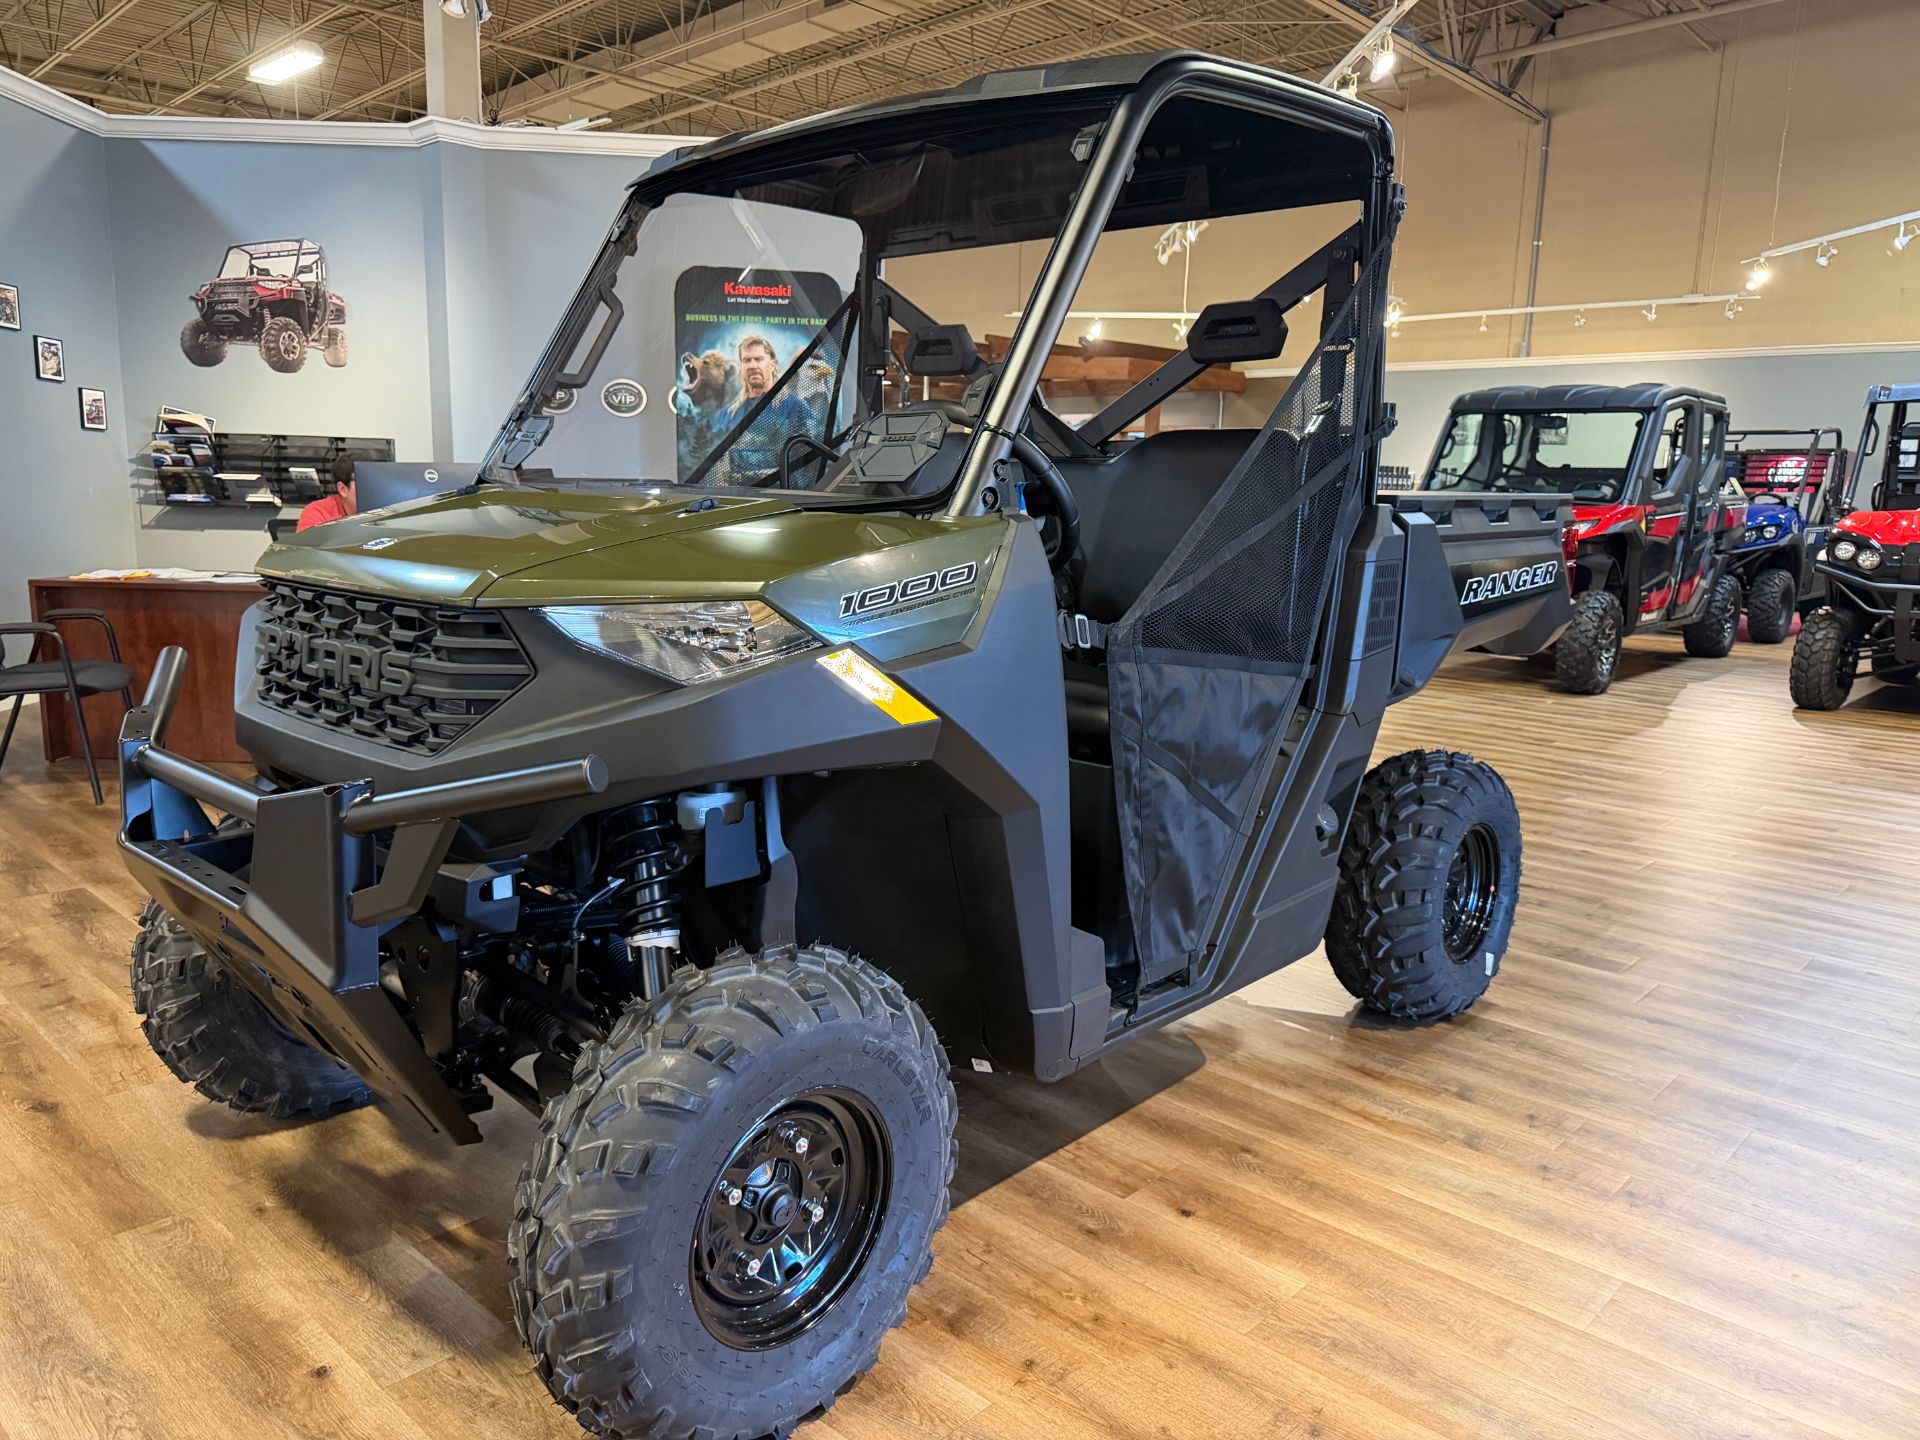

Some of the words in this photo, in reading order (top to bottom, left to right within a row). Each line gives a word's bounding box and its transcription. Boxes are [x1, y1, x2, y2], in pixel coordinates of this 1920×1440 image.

[724, 282, 792, 297] Kawasaki
[685, 314, 718, 322] BUSINESS
[719, 314, 727, 322] IN
[728, 315, 739, 323] THE
[765, 316, 787, 325] PARTY
[788, 317, 796, 325] IN
[797, 317, 809, 326] THE
[612, 394, 635, 405] VIP
[839, 560, 979, 619] 1000
[1460, 560, 1558, 606] RANGER
[841, 610, 889, 630] SINGLE
[890, 594, 951, 616] OVERHEAD
[952, 587, 976, 599] CAM
[262, 623, 414, 697] POLARIS
